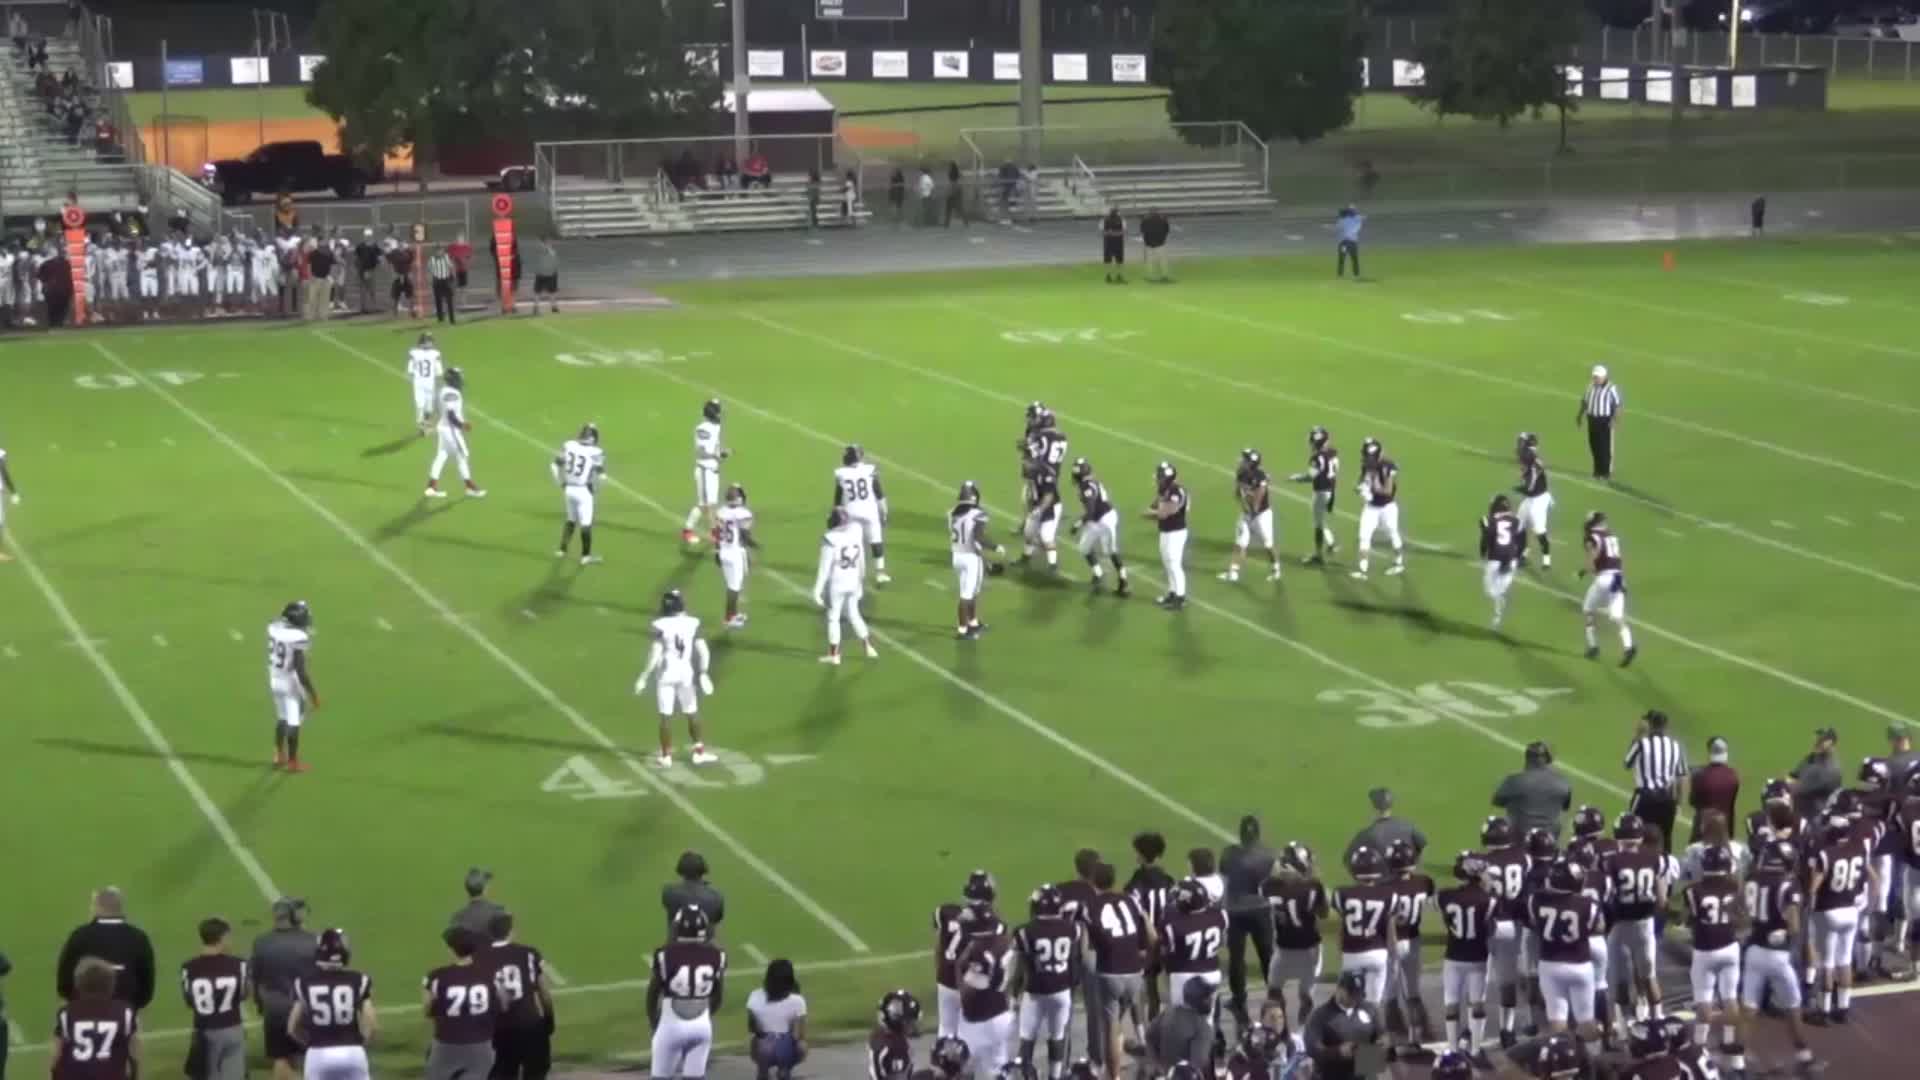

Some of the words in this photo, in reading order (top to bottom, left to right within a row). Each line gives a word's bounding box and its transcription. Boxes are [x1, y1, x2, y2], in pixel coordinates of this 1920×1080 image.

[844, 477, 869, 501] 38
[1496, 520, 1511, 546] 5
[673, 633, 686, 660] 4
[1316, 680, 1540, 729] 30
[541, 752, 766, 802] 40
[1100, 901, 1138, 938] 41
[1344, 898, 1386, 938] 27
[1446, 902, 1477, 940] 31
[1537, 906, 1580, 944] 73
[1035, 936, 1072, 974] 29
[1185, 926, 1221, 961] 72
[191, 976, 238, 1016] 87
[446, 983, 490, 1017] 79
[668, 964, 715, 998] 46
[308, 984, 355, 1027] 58
[72, 1020, 119, 1061] 57
